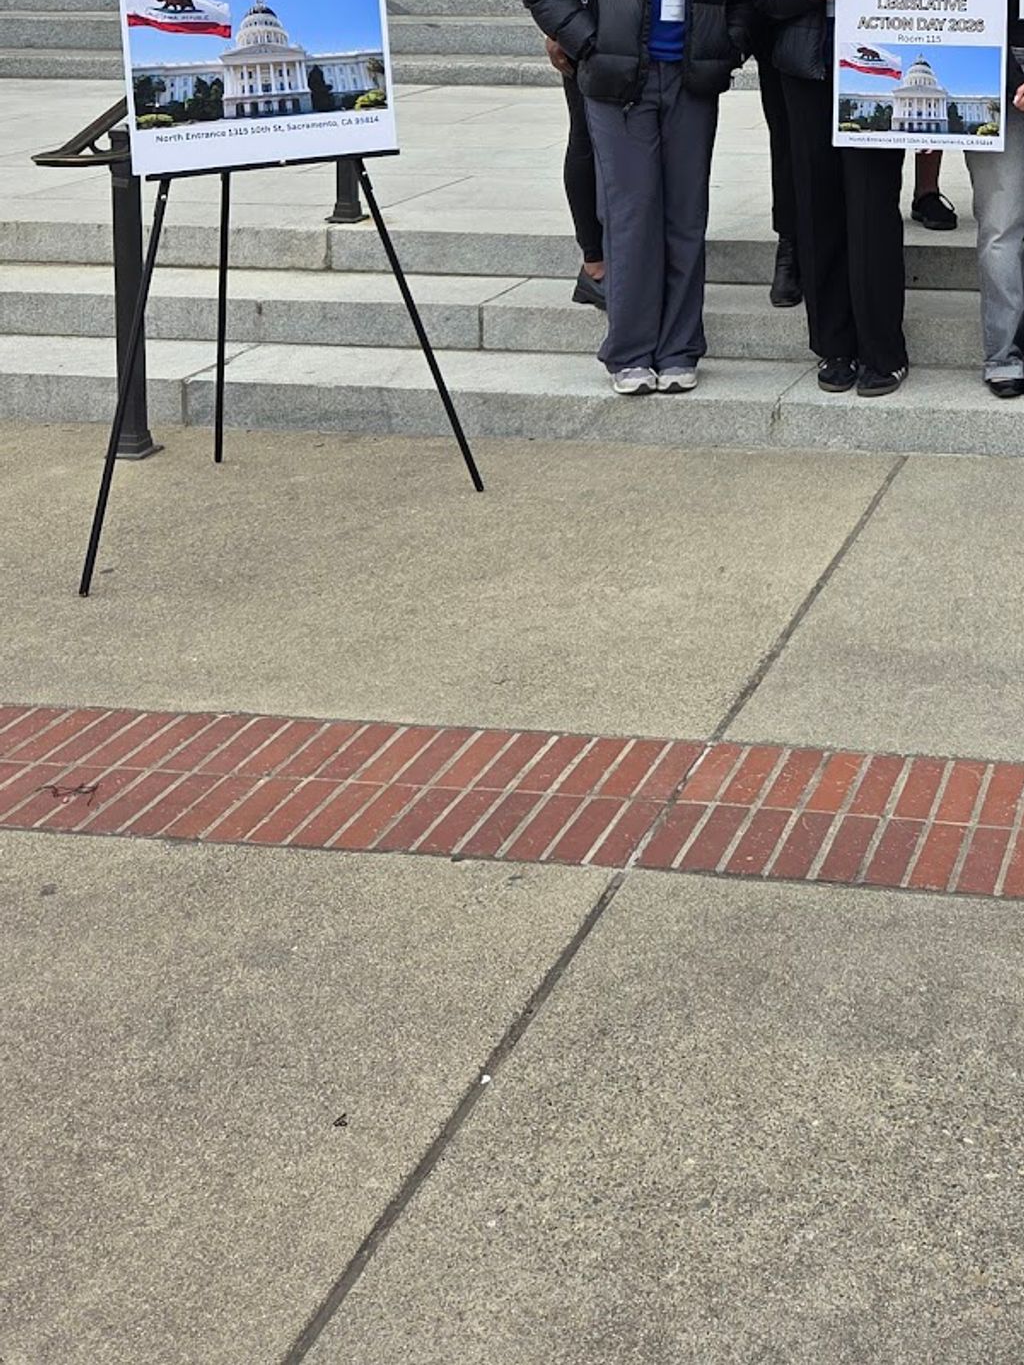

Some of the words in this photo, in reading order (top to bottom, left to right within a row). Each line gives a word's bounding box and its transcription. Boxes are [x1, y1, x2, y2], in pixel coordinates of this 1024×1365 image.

[857, 16, 914, 32] ACTION
[916, 16, 947, 32] DAY
[947, 17, 985, 33] 2026
[897, 34, 925, 43] Room
[926, 34, 942, 43] 115
[156, 133, 184, 143] North
[185, 130, 227, 141] Entrance
[286, 120, 339, 132] Sacramento,
[341, 118, 353, 127] CA
